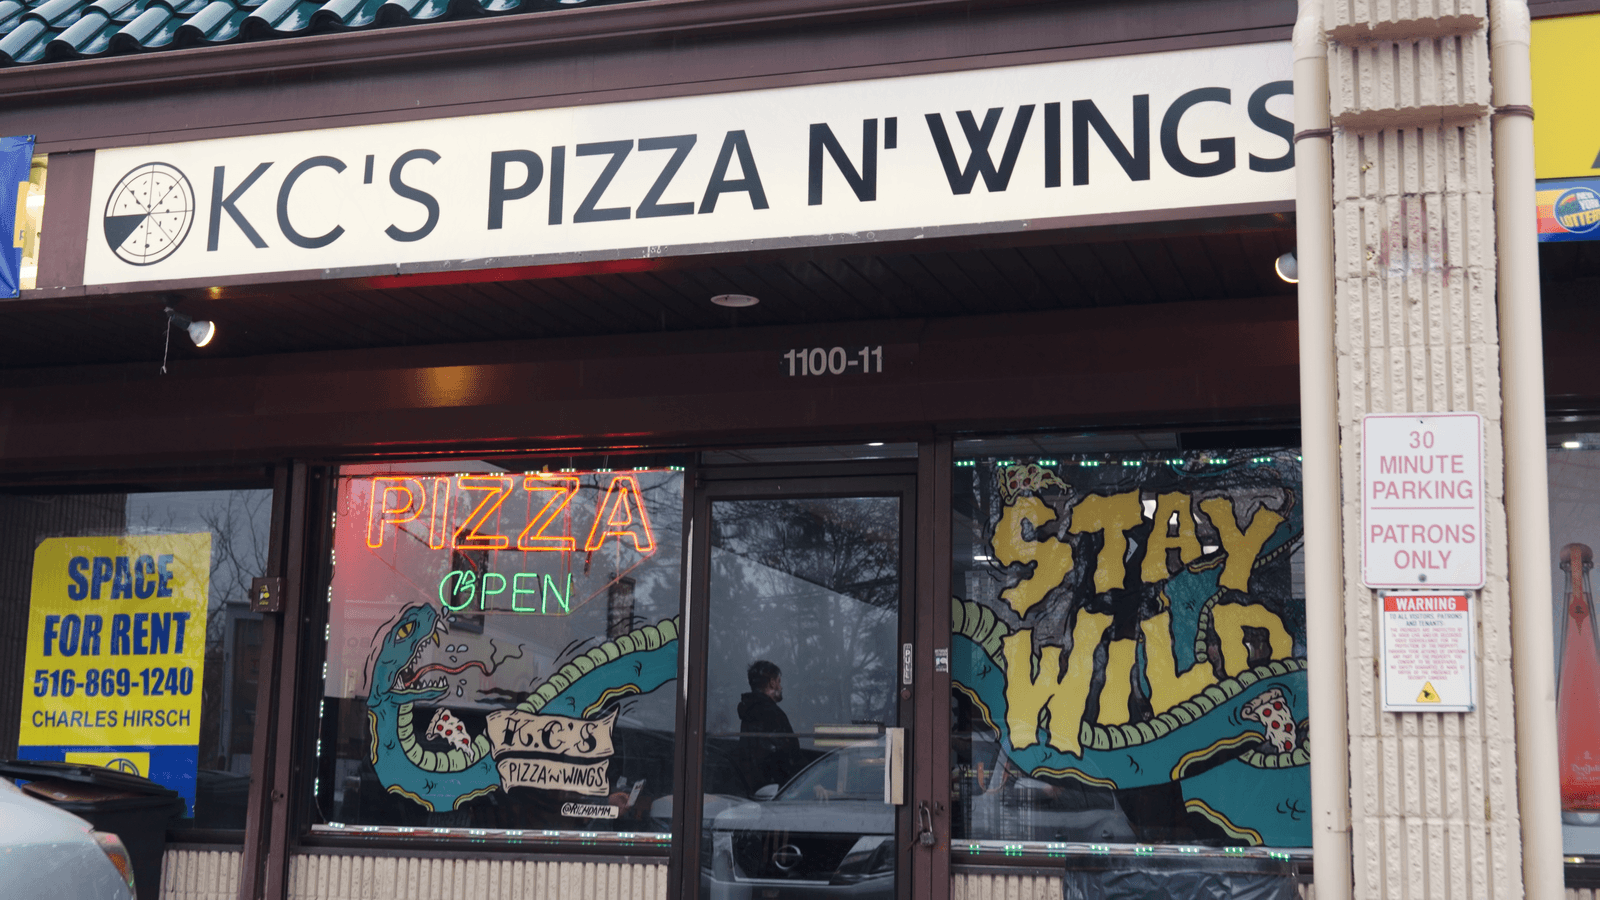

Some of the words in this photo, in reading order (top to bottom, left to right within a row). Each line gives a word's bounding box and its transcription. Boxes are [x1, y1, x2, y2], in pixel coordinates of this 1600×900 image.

[206, 148, 441, 252] KC'S
[487, 130, 770, 230] PIZZA
[808, 117, 898, 206] N'
[924, 80, 1296, 195] WINGS
[783, 345, 883, 377] 1100-11
[1409, 430, 1435, 449] 30
[1380, 454, 1464, 474] MINUTE
[1373, 479, 1473, 499] PARKING
[366, 475, 657, 552] PIZZA
[1371, 523, 1476, 544] PATRONS
[990, 487, 1288, 621] STAY
[1394, 549, 1452, 570] ONLY
[67, 553, 174, 601] SPACE
[438, 569, 573, 614] OPEN
[1395, 596, 1457, 611] WARNING
[43, 613, 104, 657] FOR
[110, 611, 192, 656] RENT
[33, 666, 194, 698] 516-869-1240
[1002, 602, 1294, 761] WILD
[32, 710, 118, 728] CHARLES
[123, 709, 191, 728] HIRSCH
